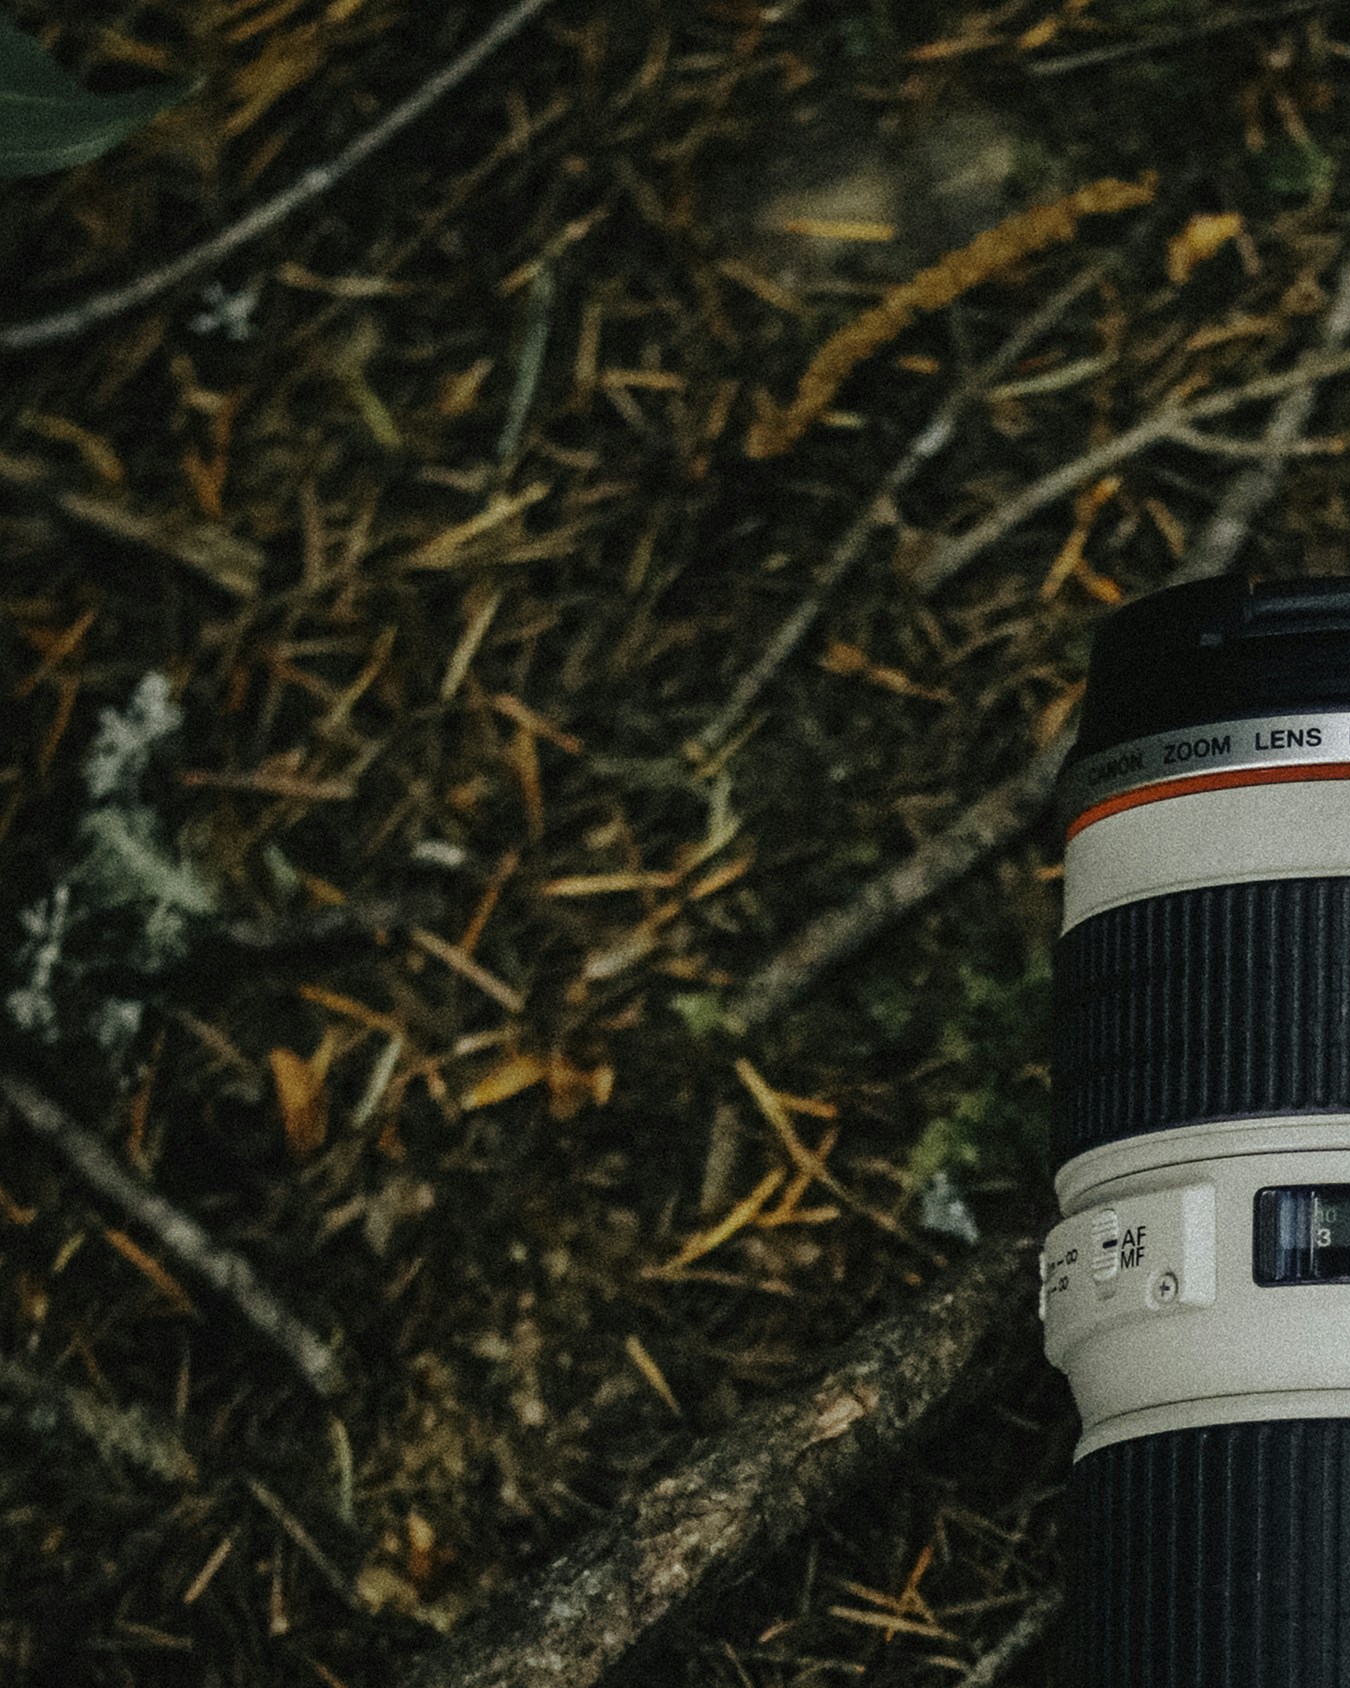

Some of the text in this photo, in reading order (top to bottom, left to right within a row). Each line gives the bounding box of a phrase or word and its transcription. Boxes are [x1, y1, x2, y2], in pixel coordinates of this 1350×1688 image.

[1163, 735, 1231, 764] ZOOM
[1254, 728, 1322, 751] LENS
[1121, 1226, 1147, 1250] AF
[1317, 1227, 1332, 1248] 3
[1120, 1246, 1145, 1270] MF
